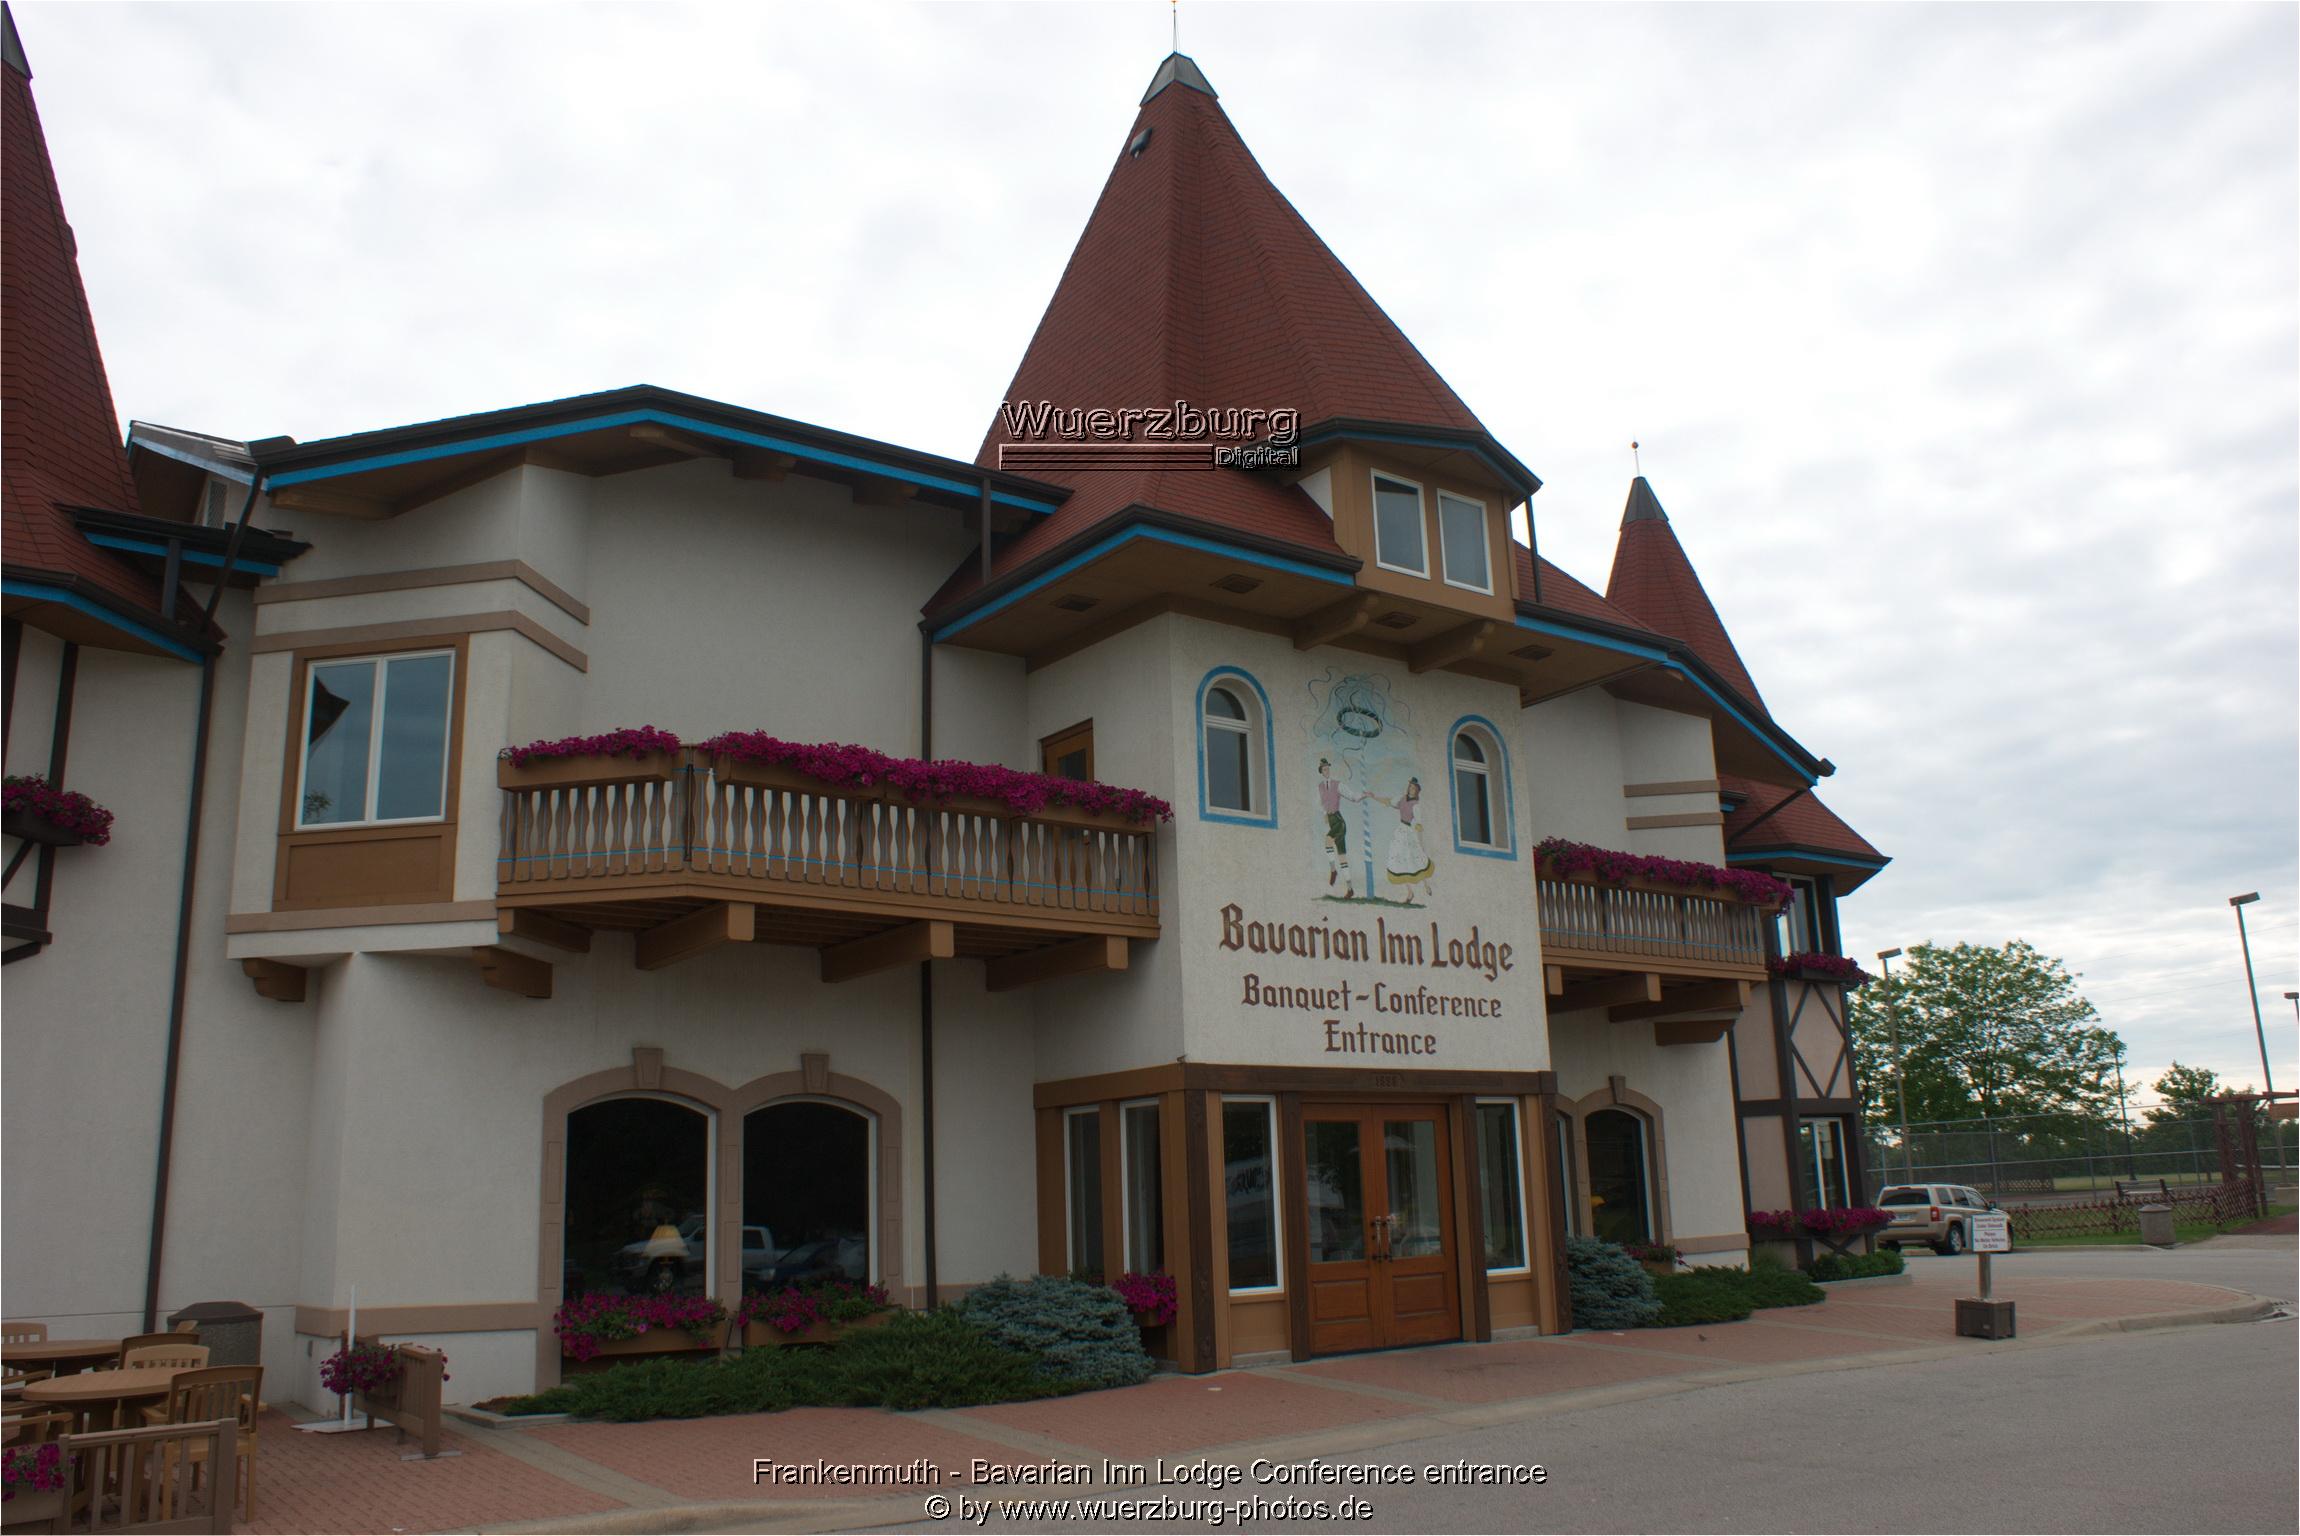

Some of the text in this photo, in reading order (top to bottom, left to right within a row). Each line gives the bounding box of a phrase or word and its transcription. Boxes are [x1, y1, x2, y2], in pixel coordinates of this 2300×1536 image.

[1219, 902, 1514, 982] Bavarian Inn Lodge
[1323, 1019, 1437, 1055] Entrance
